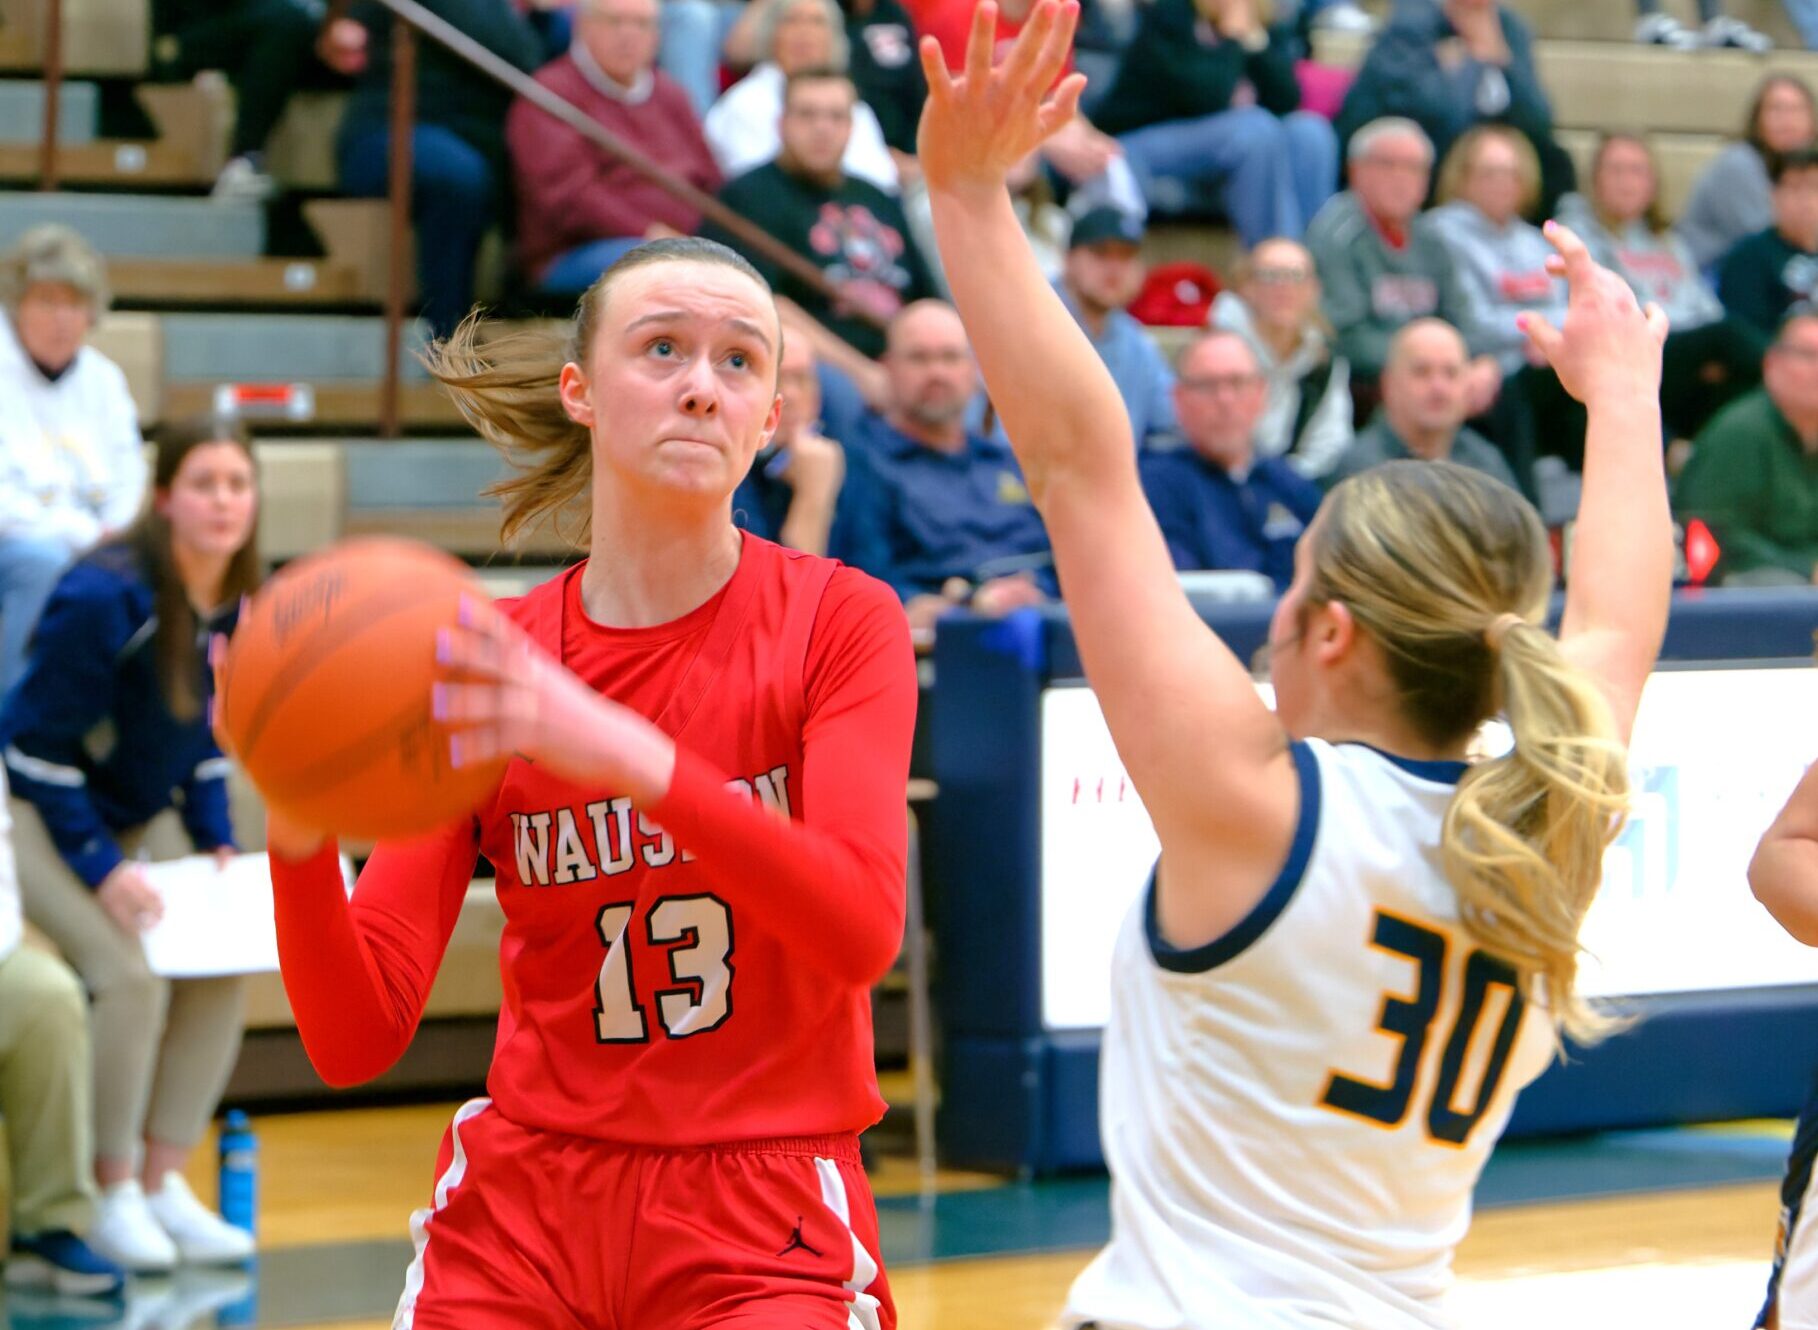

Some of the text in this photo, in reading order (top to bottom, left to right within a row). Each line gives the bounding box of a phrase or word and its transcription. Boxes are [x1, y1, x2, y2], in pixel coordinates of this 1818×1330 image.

[508, 764, 792, 887] WAUSN
[592, 892, 736, 1044] 13
[1314, 904, 1528, 1150] 30
